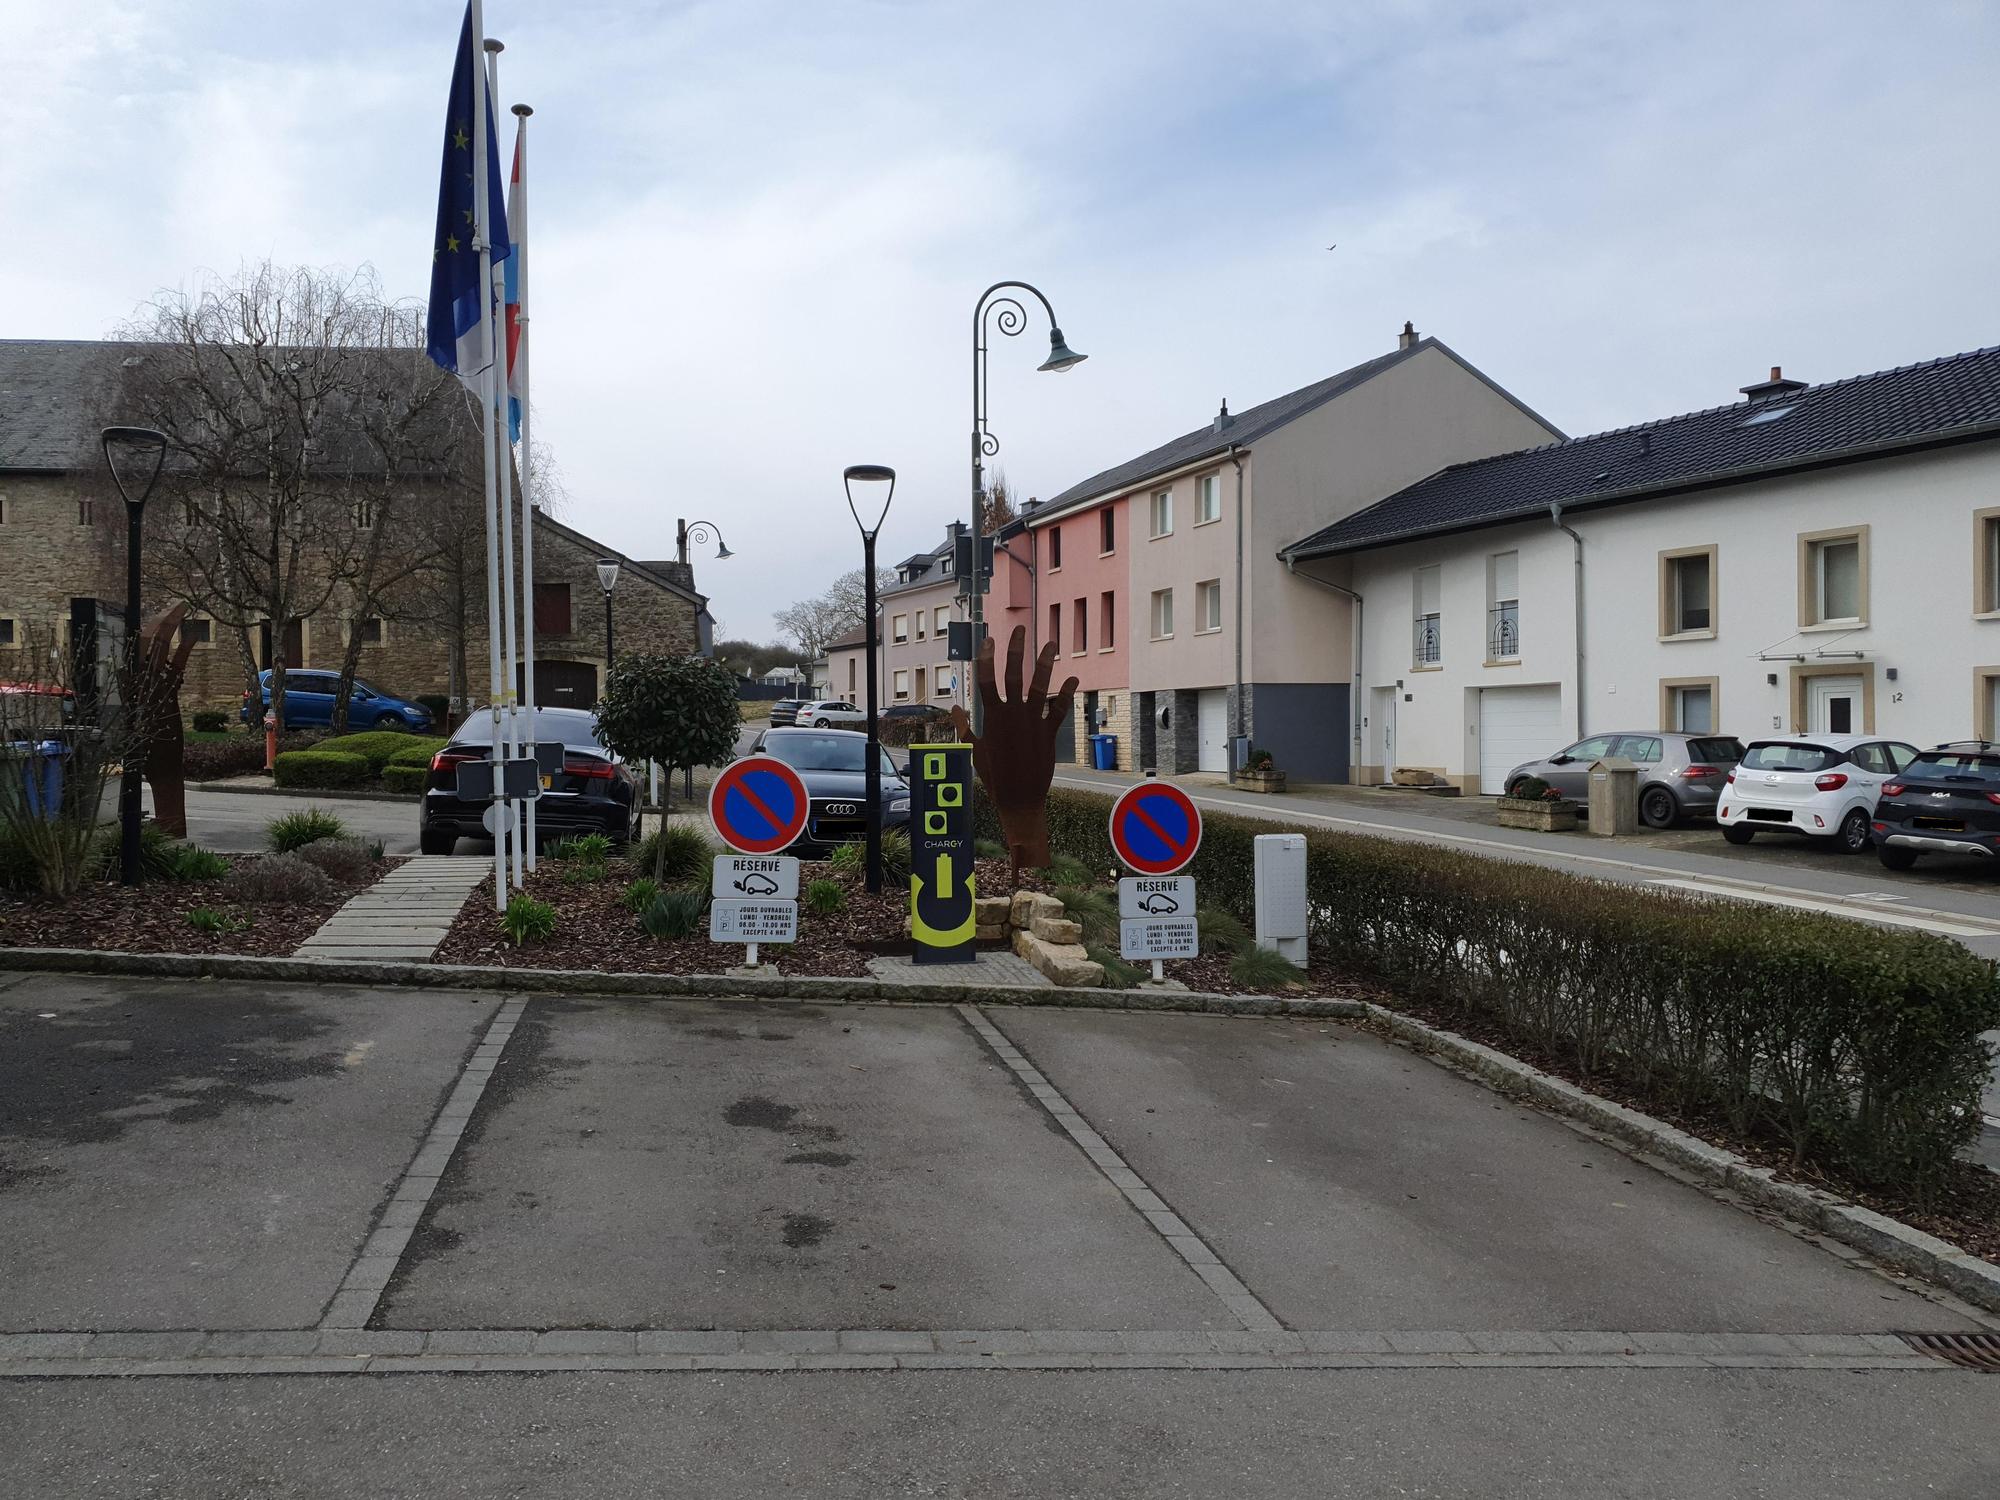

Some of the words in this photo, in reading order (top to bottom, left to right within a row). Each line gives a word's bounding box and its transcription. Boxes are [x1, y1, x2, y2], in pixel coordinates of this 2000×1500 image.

[1892, 692, 1903, 703] 12
[924, 840, 964, 849] CHARGY
[733, 858, 781, 872] RÉSERVÉ
[1136, 879, 1179, 892] RÉSERVÉ
[760, 906, 793, 914] OUVRABLES
